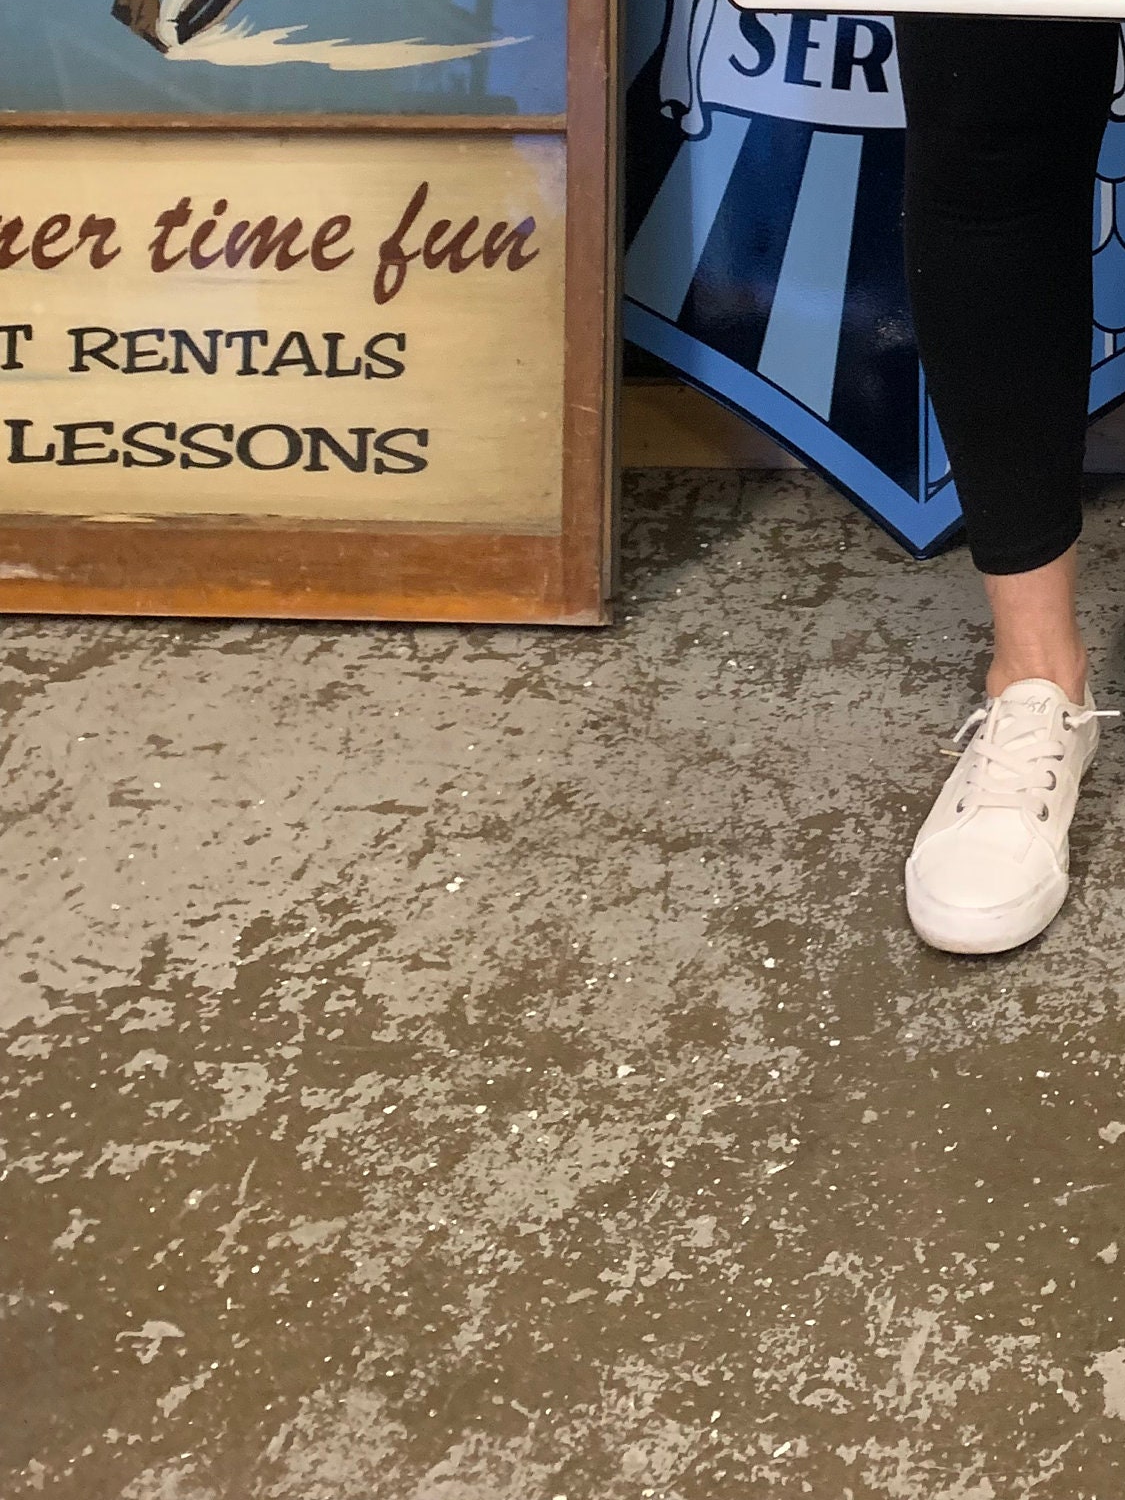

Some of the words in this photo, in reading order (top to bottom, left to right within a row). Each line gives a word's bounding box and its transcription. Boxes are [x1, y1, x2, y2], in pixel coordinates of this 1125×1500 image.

[147, 196, 356, 273] time
[372, 181, 540, 305] fun
[67, 326, 406, 379] RENTALS
[4, 418, 429, 474] LESSONS
